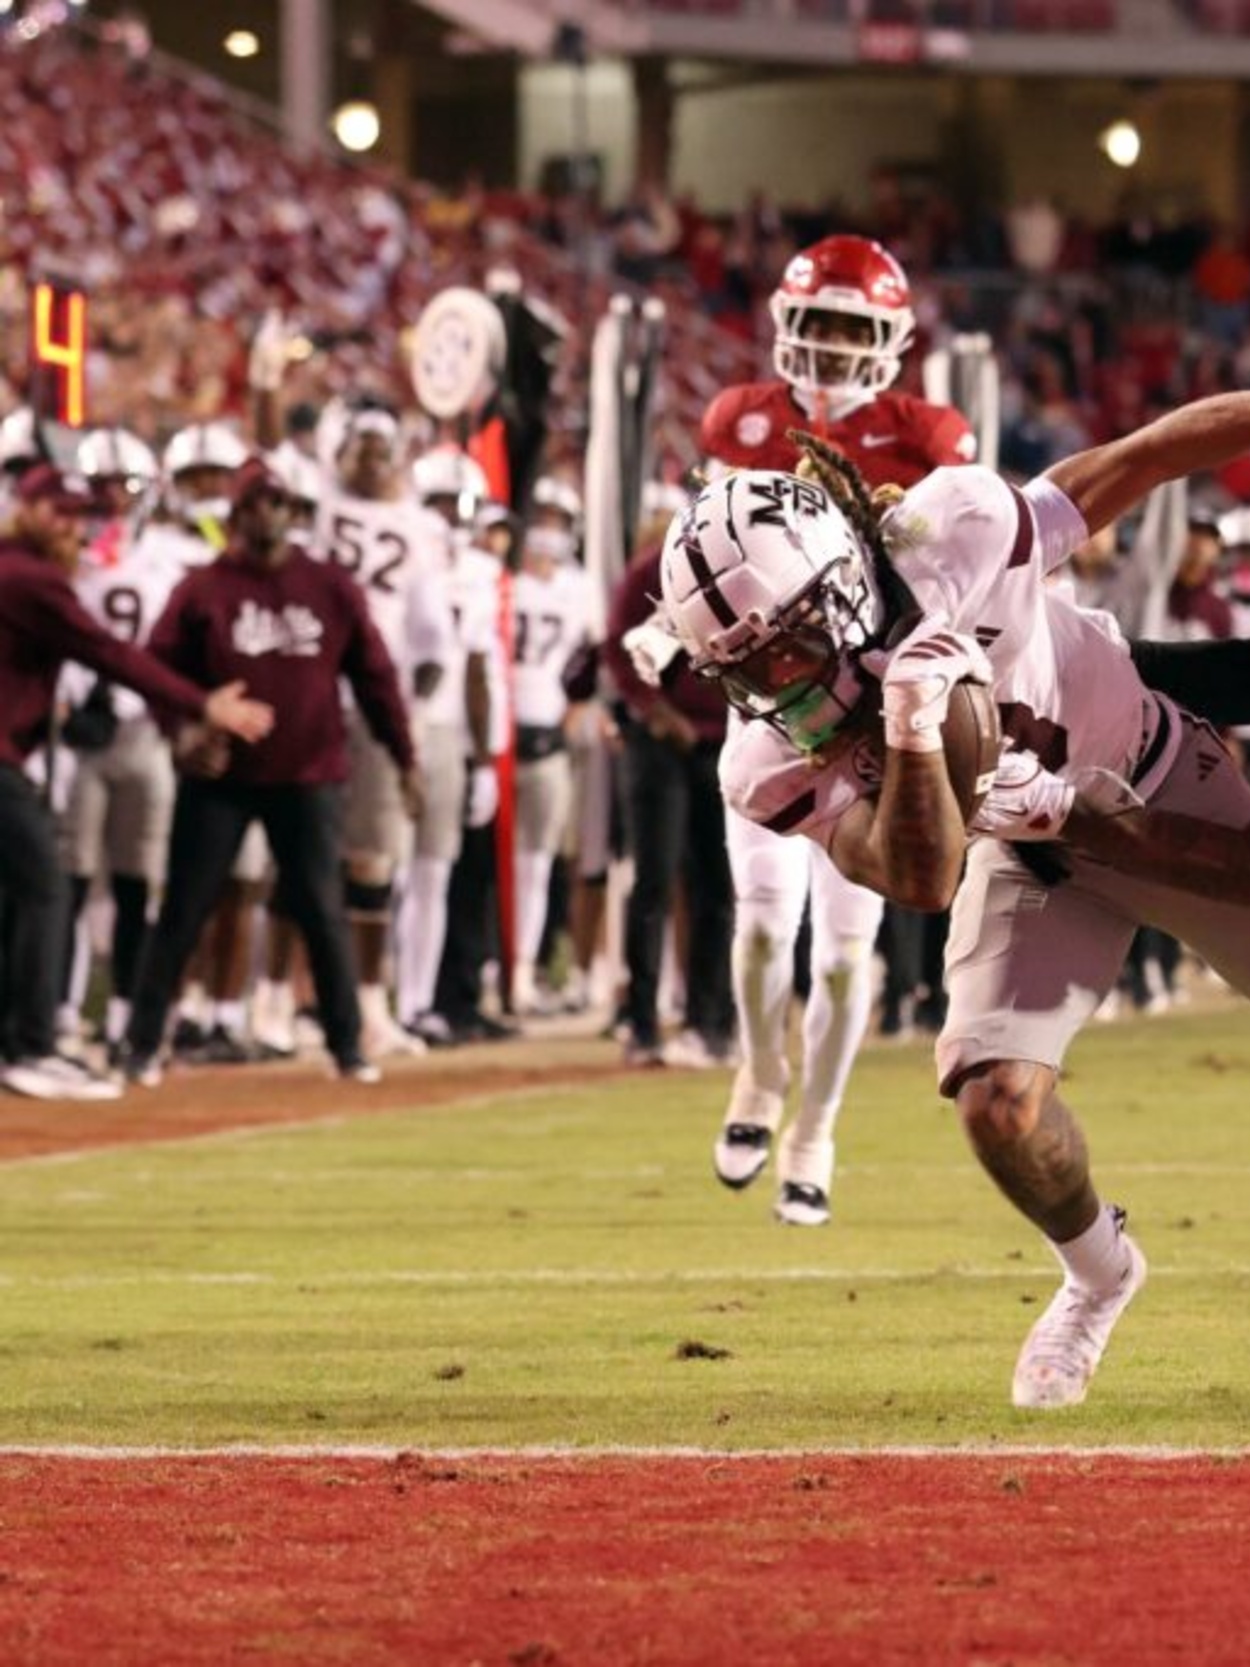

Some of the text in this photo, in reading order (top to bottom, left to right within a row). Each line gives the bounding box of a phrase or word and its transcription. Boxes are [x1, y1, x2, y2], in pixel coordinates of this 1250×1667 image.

[36, 283, 85, 427] 4
[327, 515, 408, 594] 52
[104, 587, 142, 641] 9
